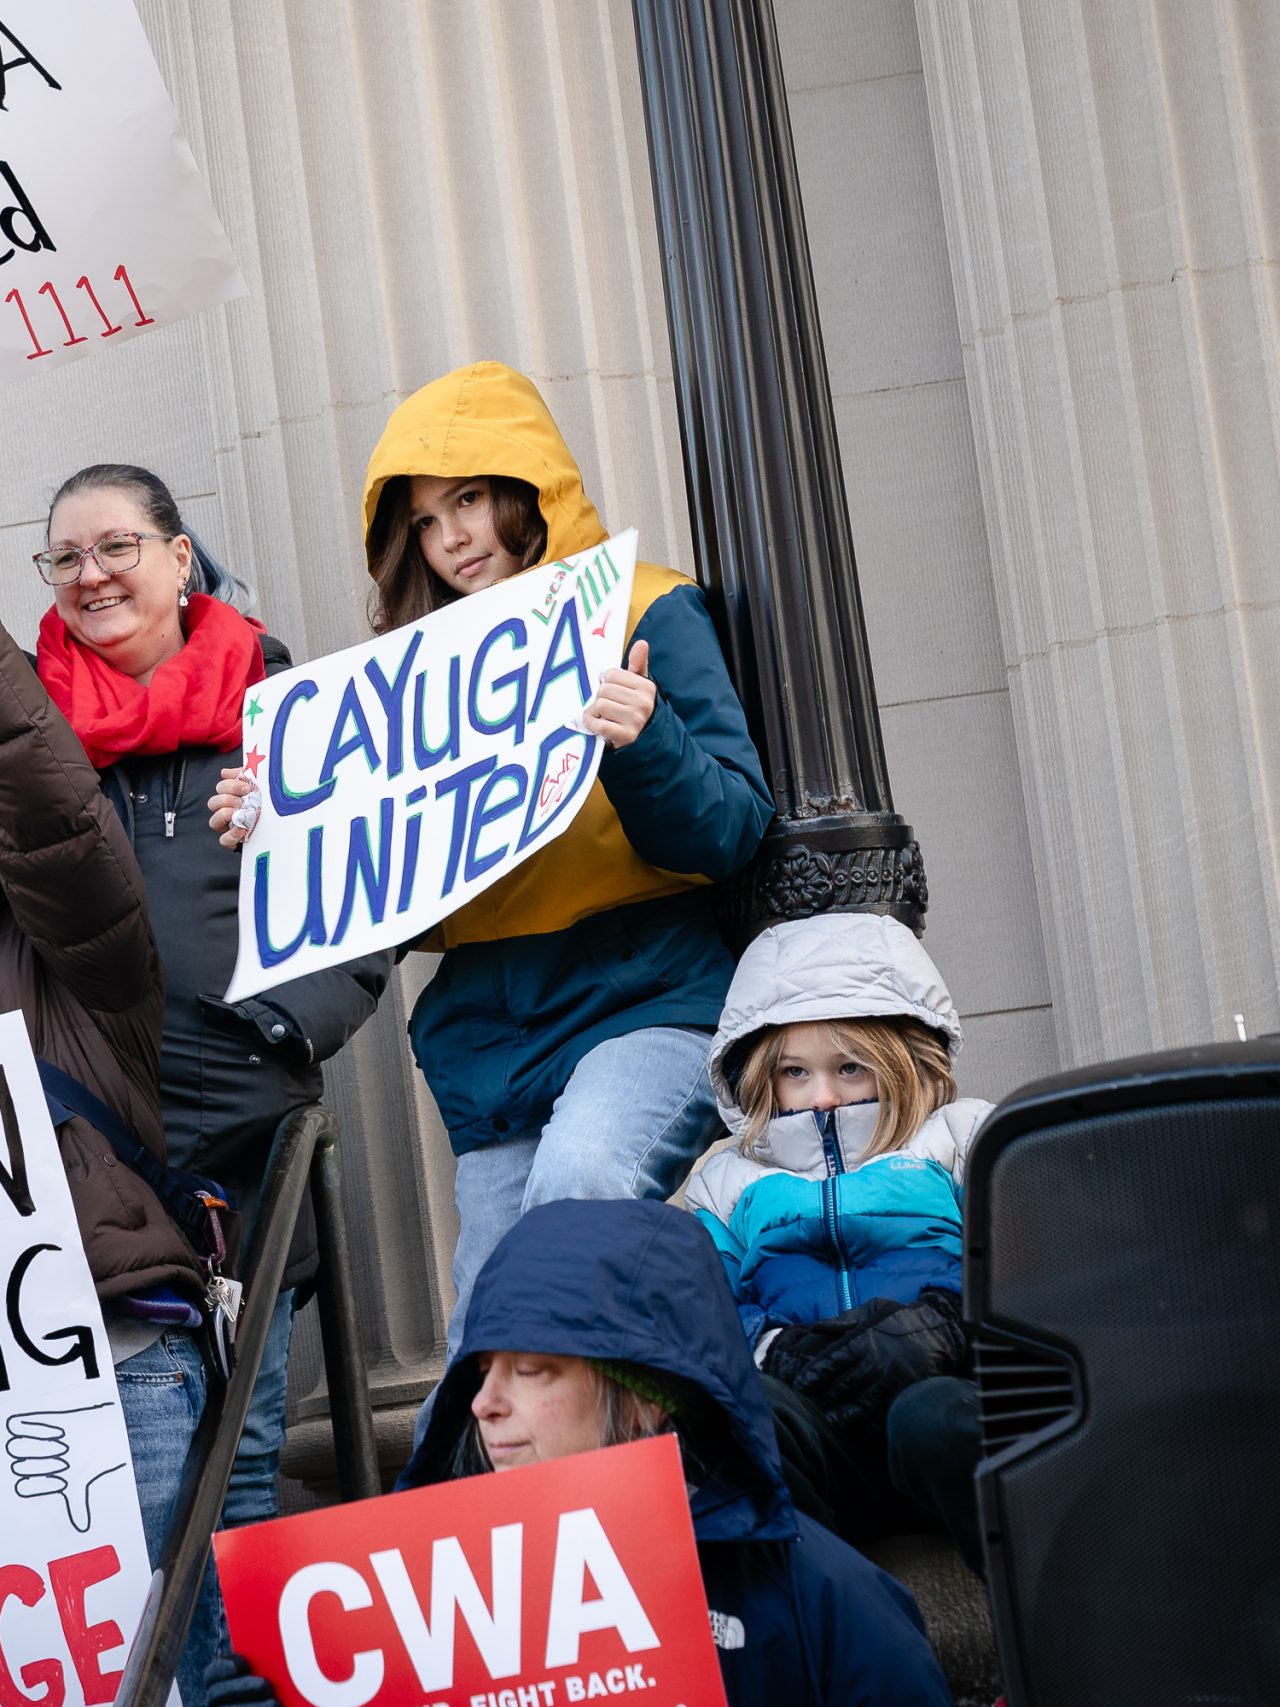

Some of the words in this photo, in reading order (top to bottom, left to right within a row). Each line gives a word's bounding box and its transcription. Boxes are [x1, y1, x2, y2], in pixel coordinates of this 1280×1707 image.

[5, 264, 156, 360] 1111
[268, 597, 593, 817] CAYUGA
[278, 1506, 661, 1707] CWA
[564, 1663, 657, 1702] BACK.
